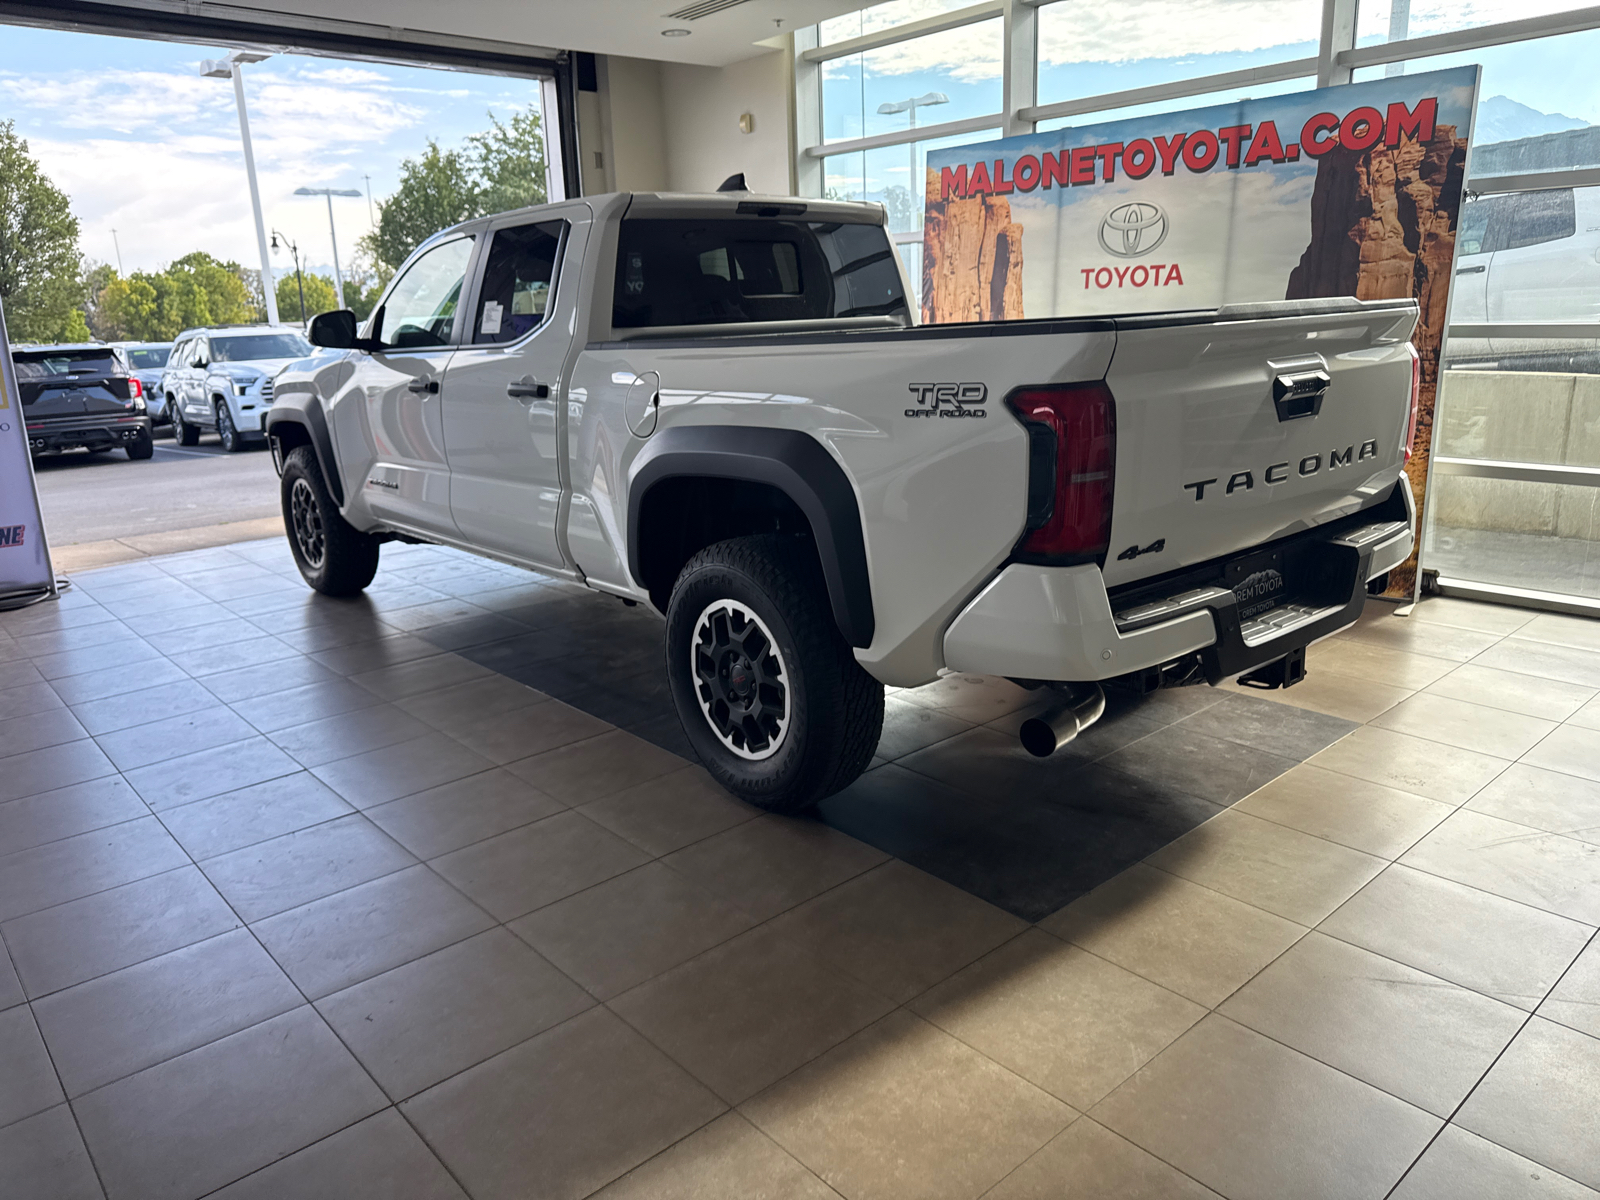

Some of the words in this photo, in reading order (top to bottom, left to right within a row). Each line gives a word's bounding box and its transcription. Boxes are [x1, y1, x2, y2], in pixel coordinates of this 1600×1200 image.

[940, 97, 1437, 199] MALONETOYOTA.COM
[1081, 264, 1184, 290] TOYOTA
[909, 383, 988, 409] TRD
[904, 409, 937, 418] OFF
[939, 409, 987, 418] ROAD
[1184, 438, 1379, 502] TACOMA
[1254, 576, 1283, 596] TOYOTA
[1242, 606, 1257, 618] OREM
[1257, 600, 1275, 613] TOYOTA
